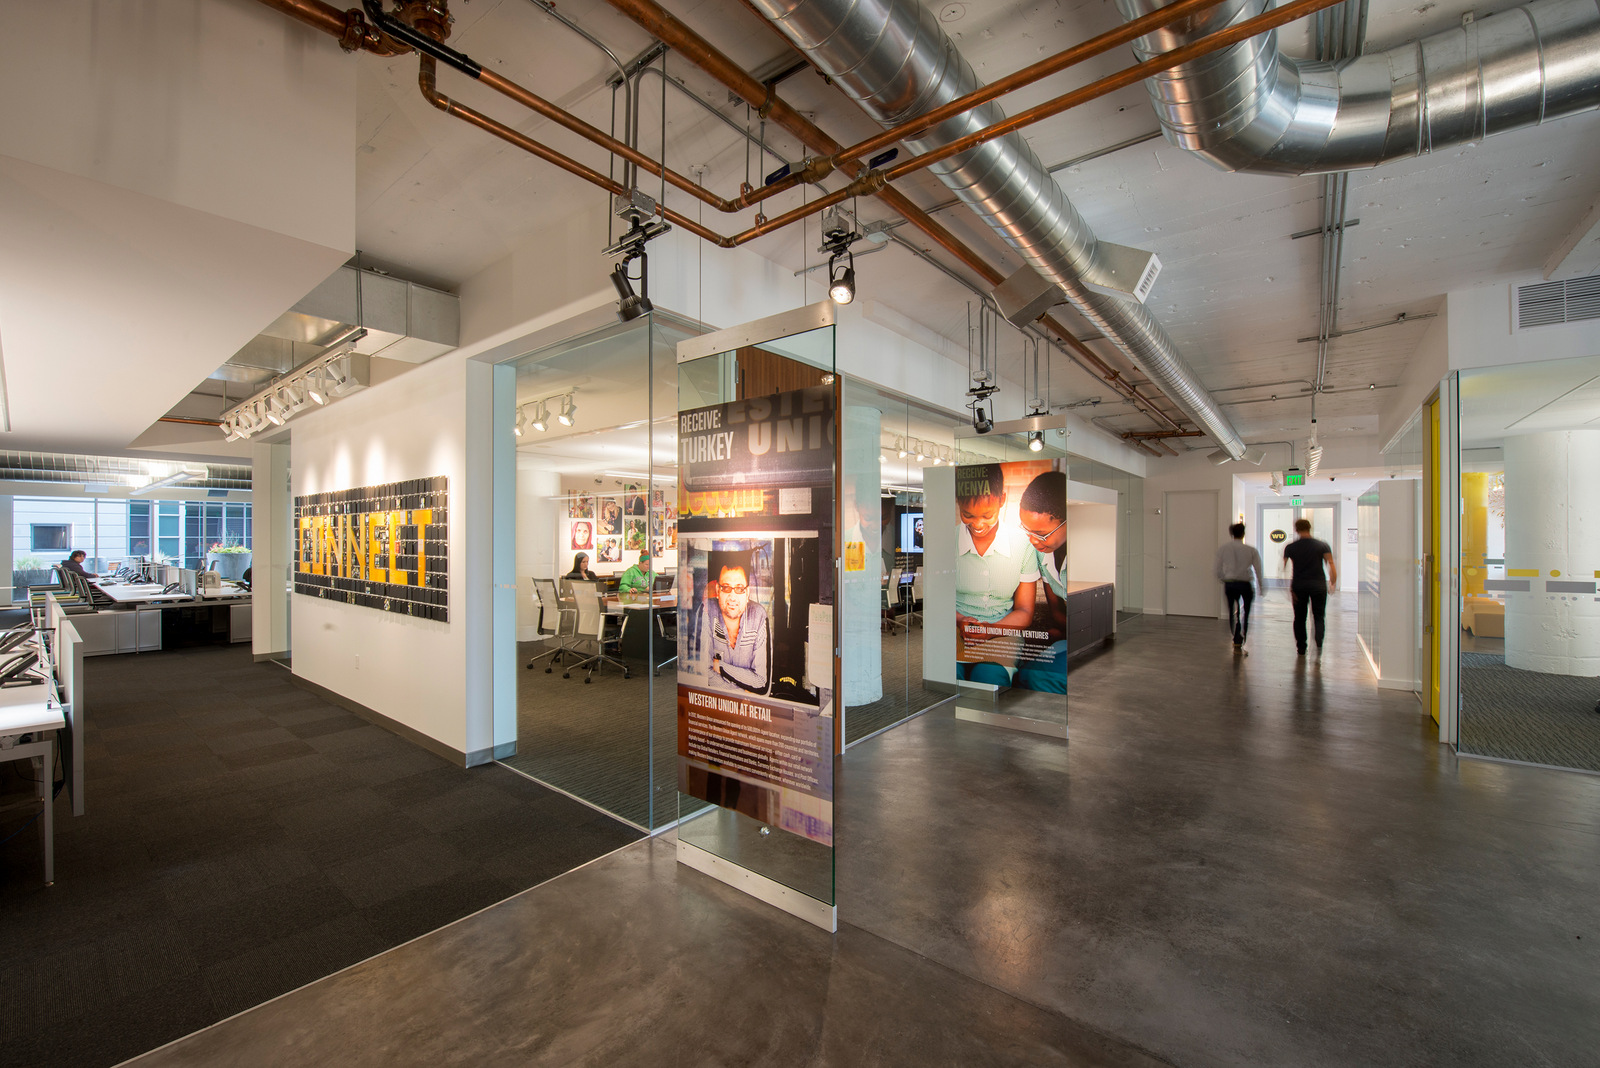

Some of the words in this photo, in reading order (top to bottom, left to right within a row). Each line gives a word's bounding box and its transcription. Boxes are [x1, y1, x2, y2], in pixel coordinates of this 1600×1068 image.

[681, 409, 721, 433] RECEIVE:
[748, 414, 834, 455] UNI
[681, 431, 734, 464] TURKEY
[957, 467, 988, 479] RECEIVE:
[1286, 475, 1302, 486] EXIT
[957, 480, 991, 496] KENYA
[299, 509, 432, 588] CONNECT
[964, 625, 986, 634] WESTERN
[986, 627, 1002, 636] UNION
[1003, 628, 1021, 638] DIGITAL
[1022, 630, 1049, 640] VENTURES
[688, 692, 717, 710] WESTERN
[718, 698, 738, 715] UNION
[740, 703, 748, 717] AT
[749, 705, 772, 722] RETAIL
